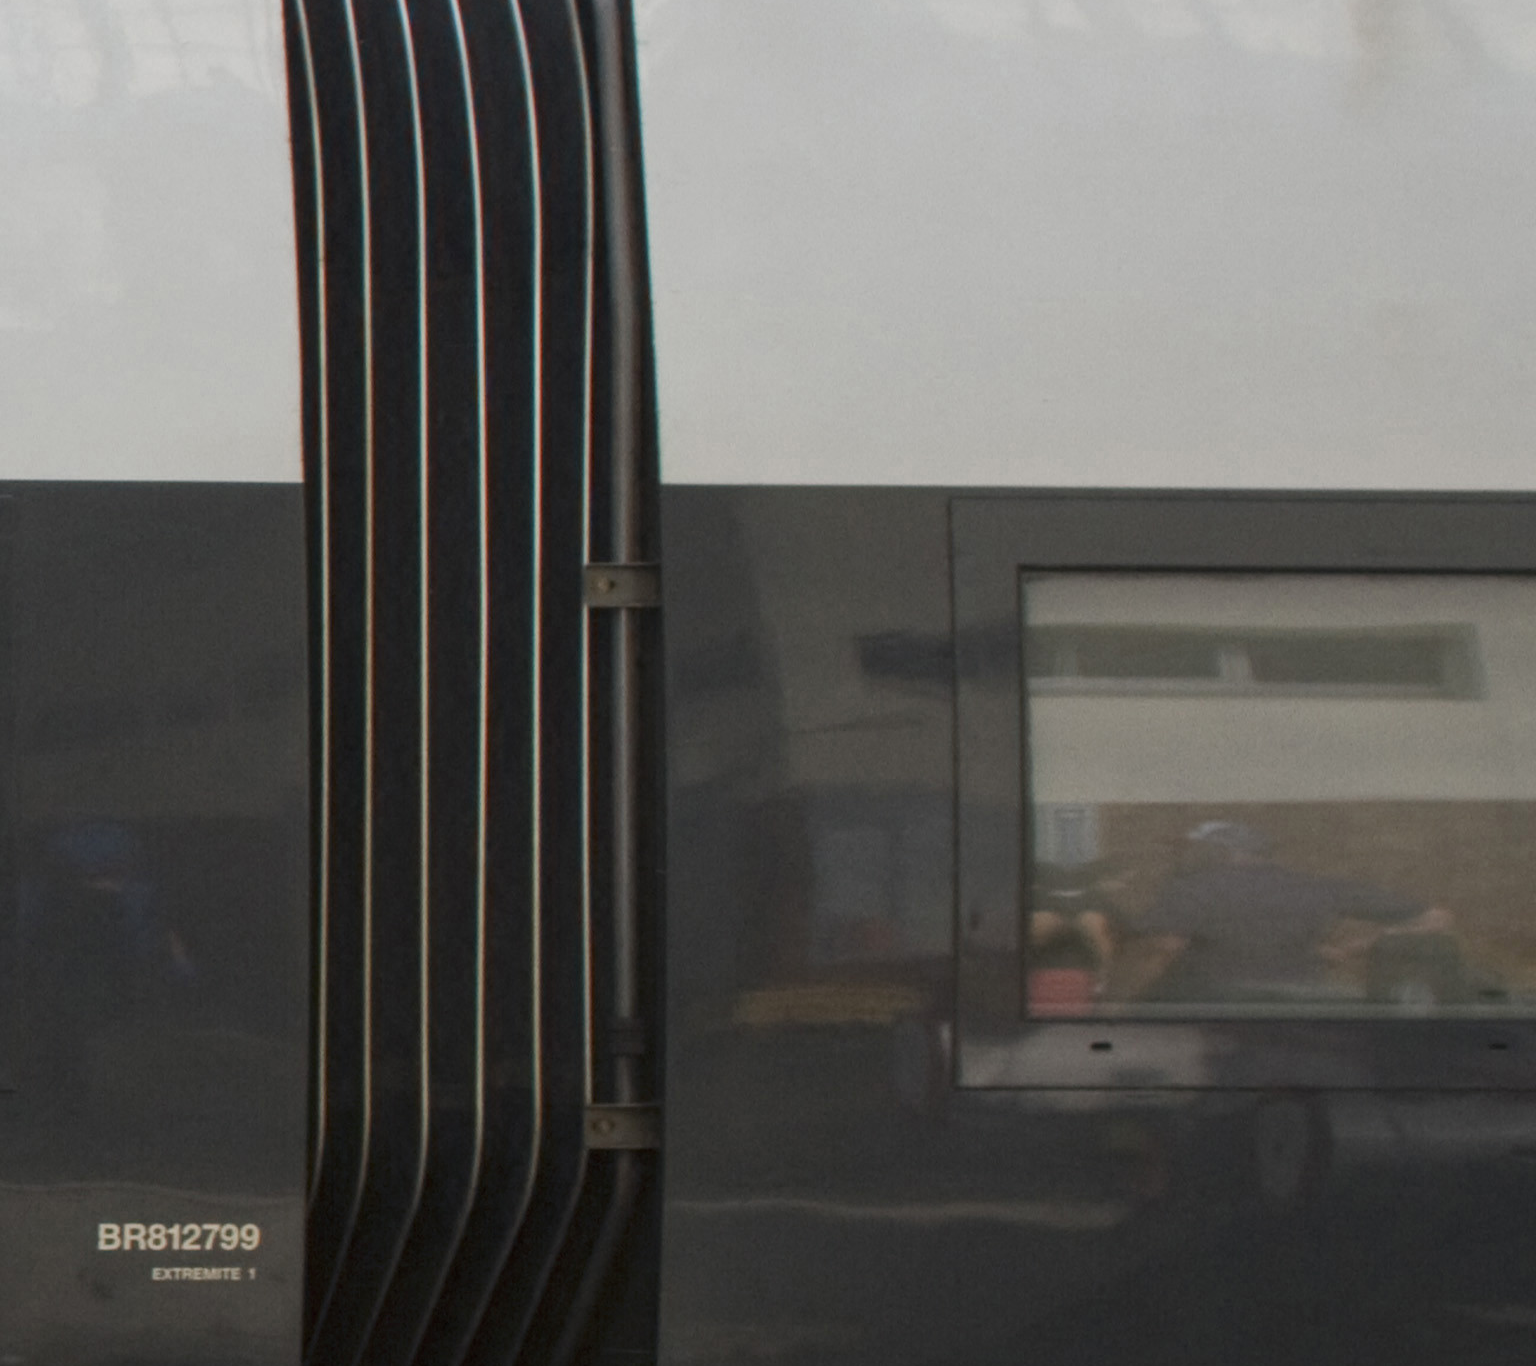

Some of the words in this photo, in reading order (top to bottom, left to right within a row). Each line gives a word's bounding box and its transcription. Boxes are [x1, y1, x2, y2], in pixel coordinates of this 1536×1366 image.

[97, 1222, 261, 1251] BR812799
[152, 1267, 241, 1281] EXTREMITE
[247, 1267, 257, 1280] 1
